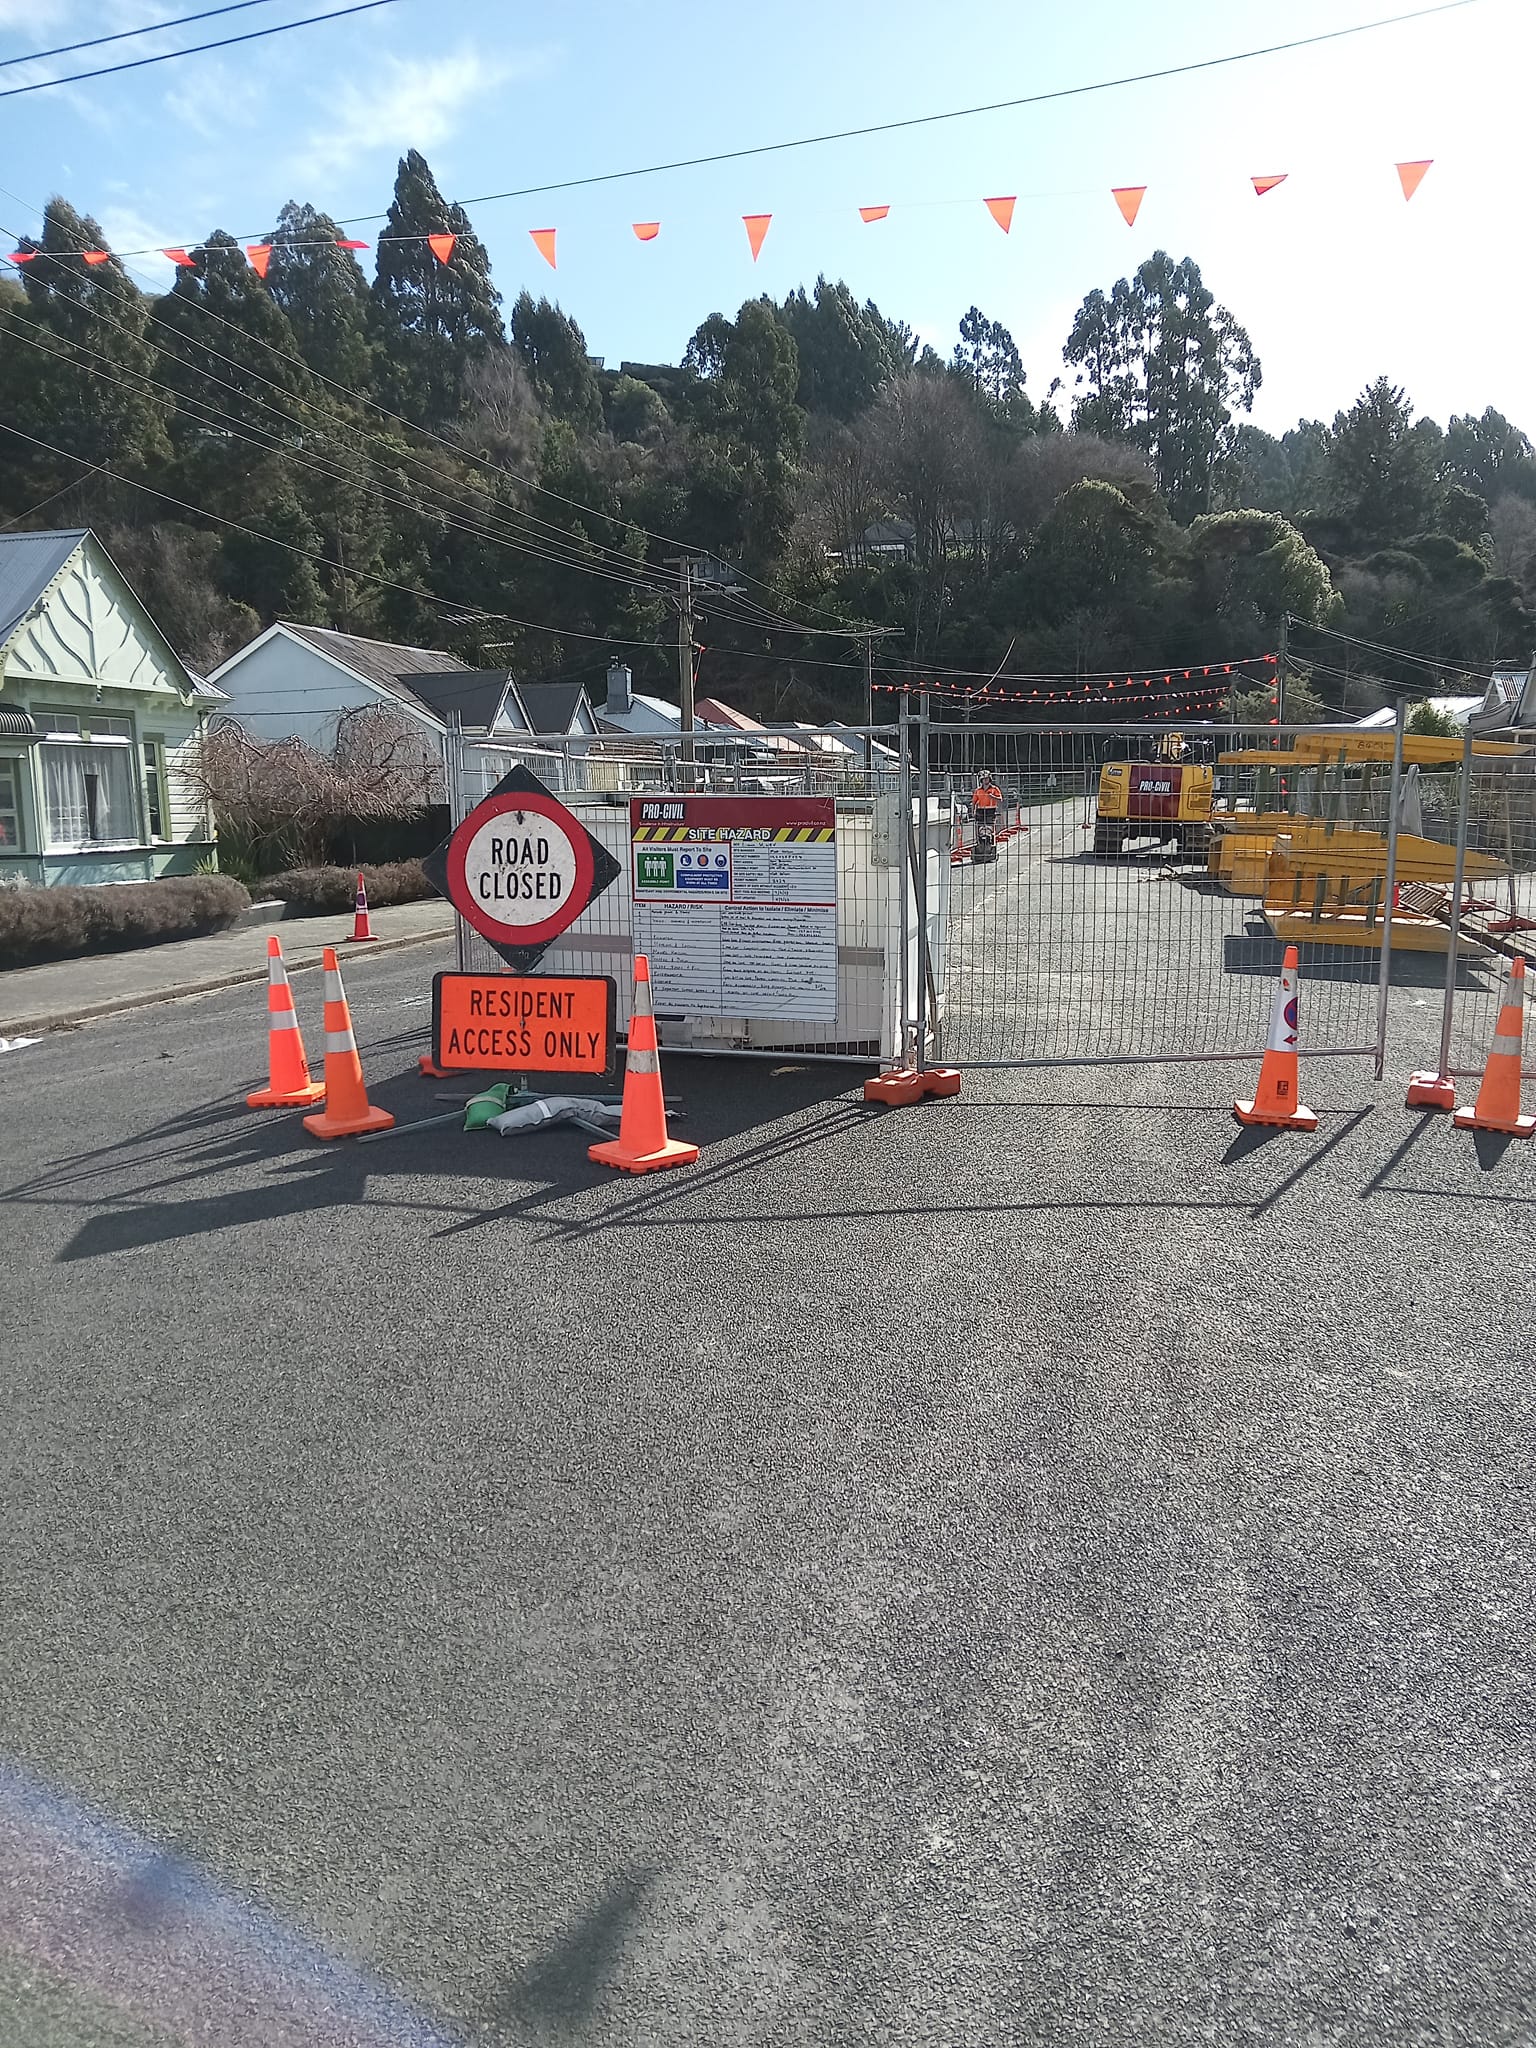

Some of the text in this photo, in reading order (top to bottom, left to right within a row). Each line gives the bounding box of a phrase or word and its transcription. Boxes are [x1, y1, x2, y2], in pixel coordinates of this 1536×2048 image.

[1139, 780, 1171, 793] PRO-CIVIL
[642, 803, 685, 819] PRO-CIVIL
[689, 829, 771, 840] SITE HAZARD
[492, 838, 549, 865] ROAD
[480, 872, 562, 900] CLOSED
[470, 990, 576, 1018] RESIDENT
[448, 1028, 600, 1059] ACCESS ONLY
